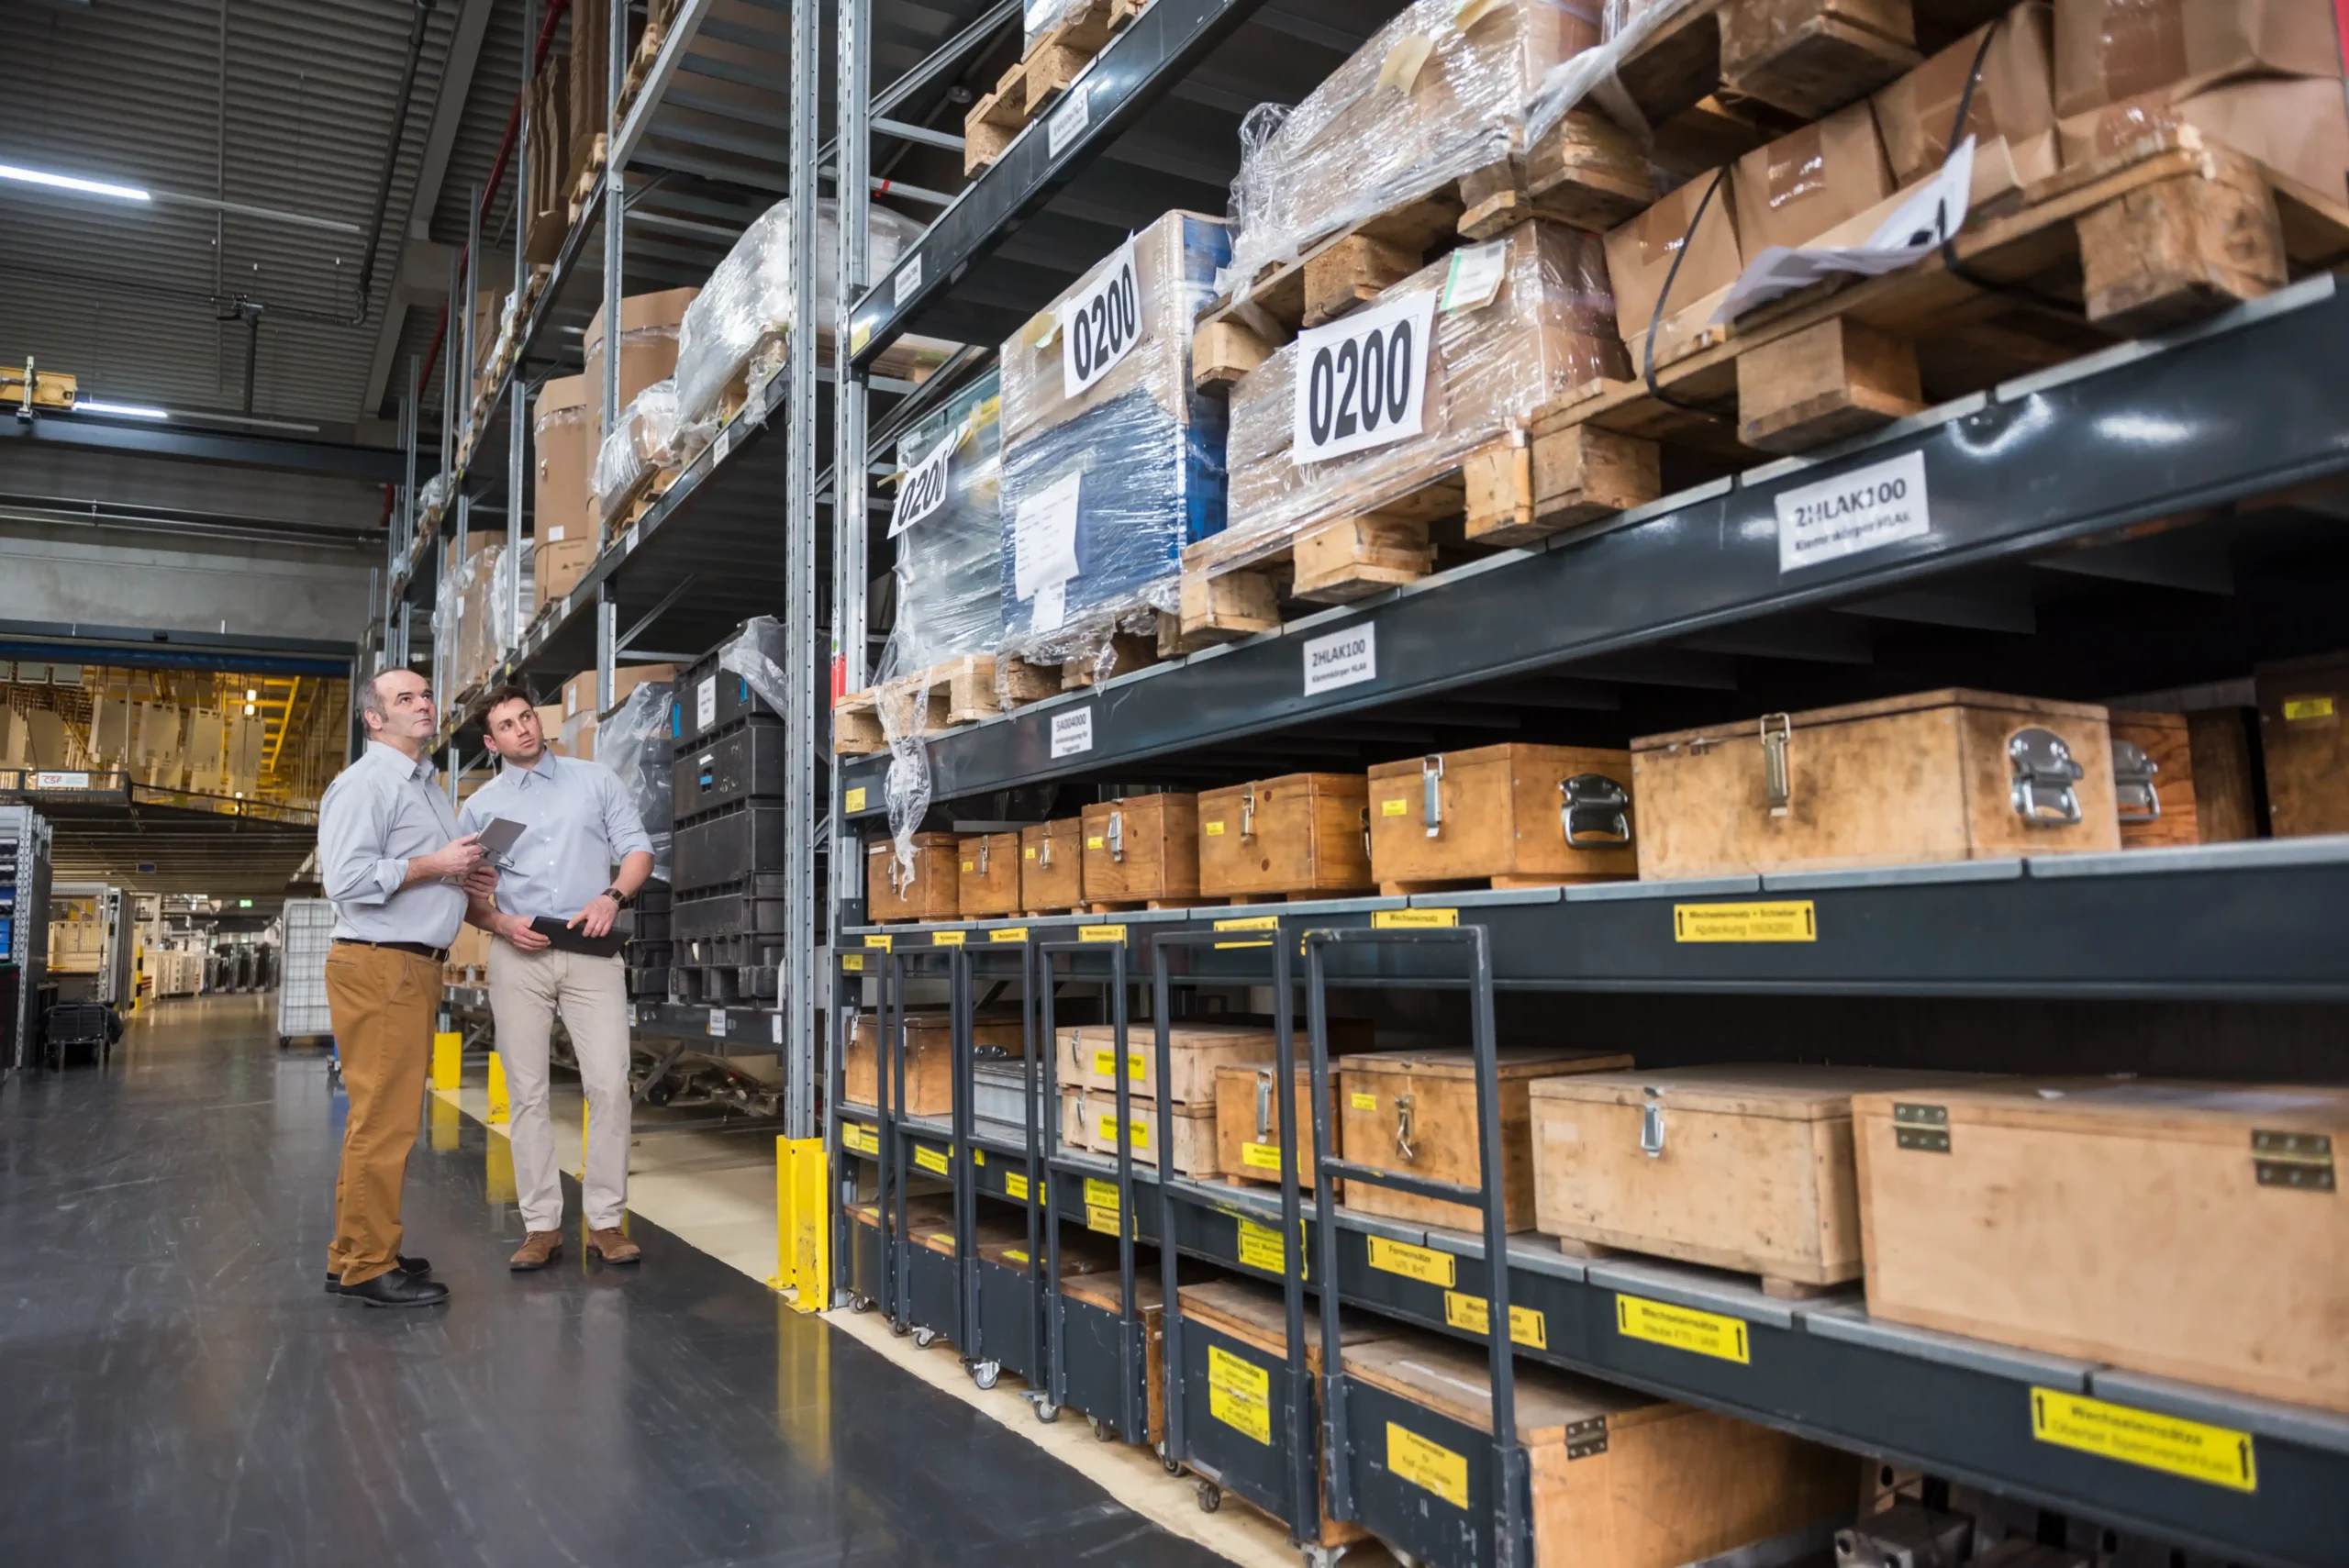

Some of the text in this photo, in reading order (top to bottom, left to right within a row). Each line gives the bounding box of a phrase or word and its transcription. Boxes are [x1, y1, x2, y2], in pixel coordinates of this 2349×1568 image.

[1074, 262, 1135, 381] 0200
[1309, 318, 1412, 447] 0200
[897, 450, 948, 527] 0200
[1795, 478, 1907, 528] 2HLAK100
[1312, 639, 1366, 668] 2HLAK100
